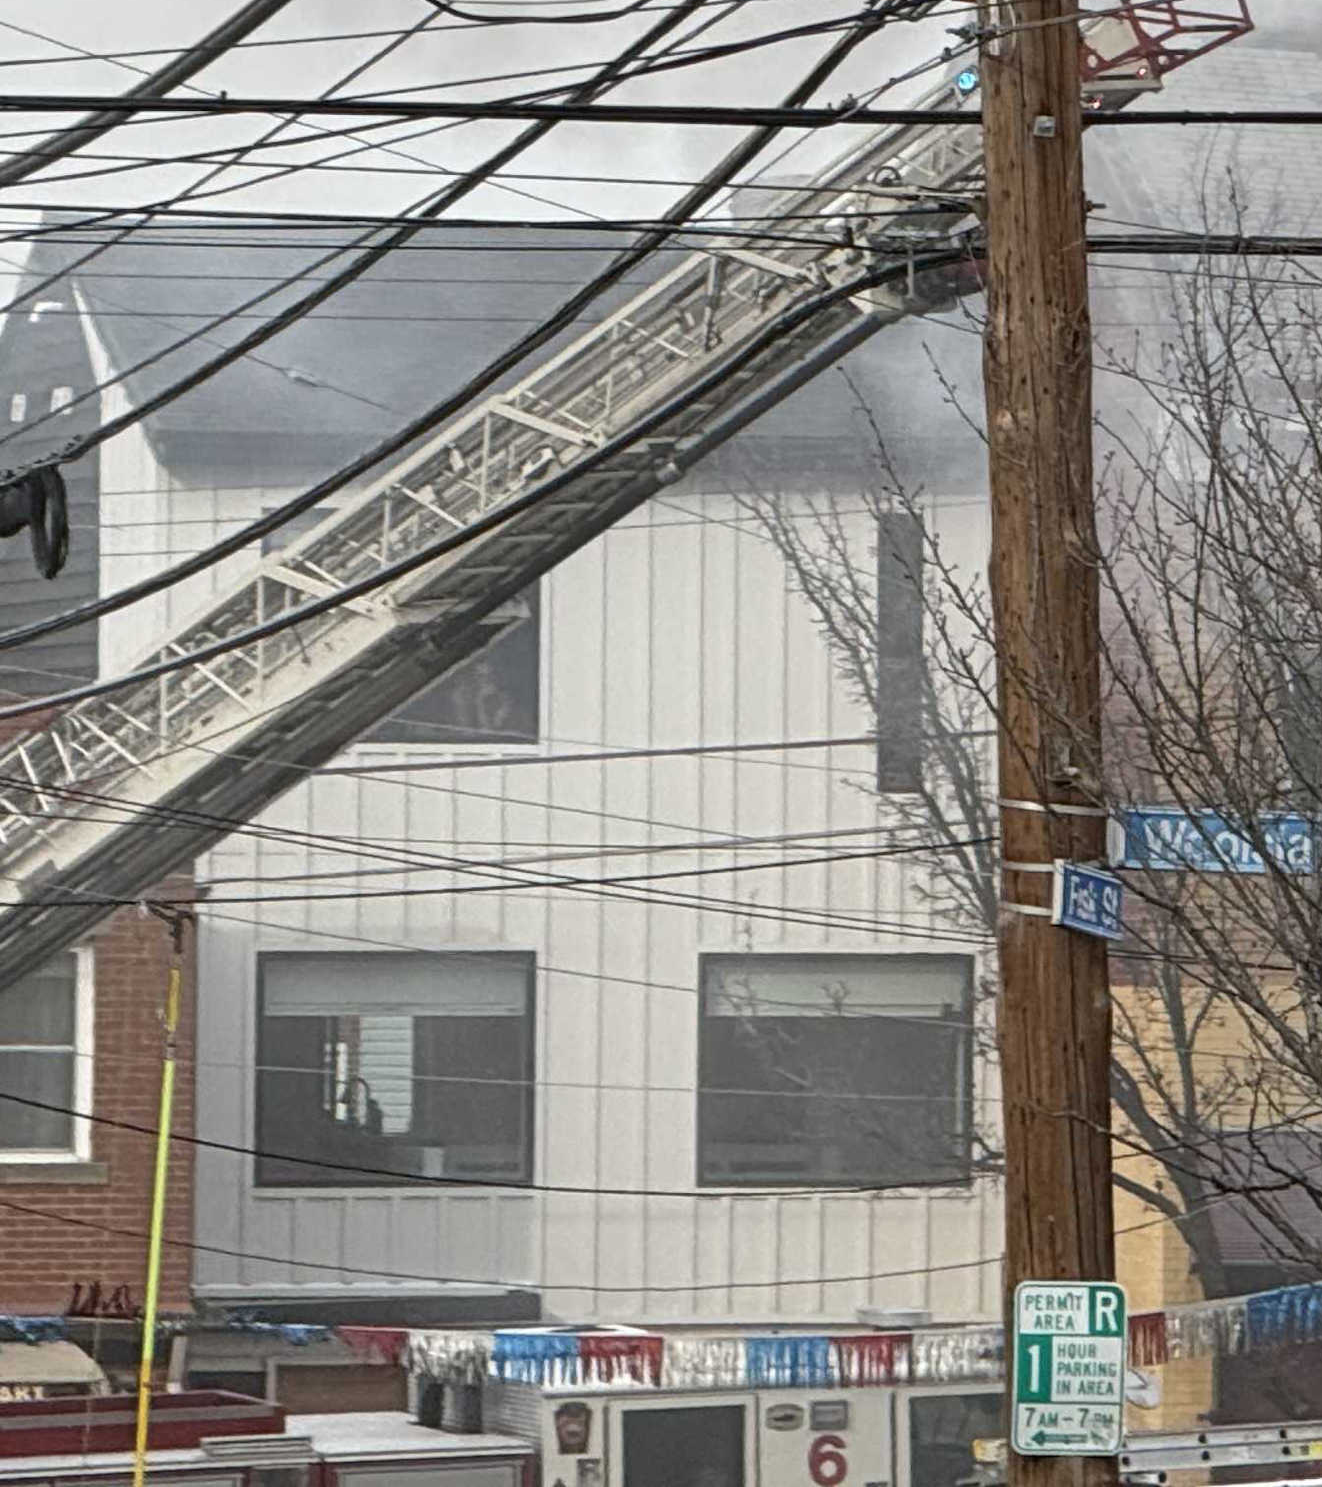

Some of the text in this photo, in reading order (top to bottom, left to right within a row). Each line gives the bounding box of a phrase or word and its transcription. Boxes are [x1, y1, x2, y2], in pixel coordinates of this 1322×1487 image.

[1024, 1290, 1119, 1332] PERMIT R
[1034, 1314, 1076, 1331] AREA
[1057, 1343, 1097, 1359] HOUR
[1027, 1344, 1041, 1394] 1
[1057, 1363, 1118, 1379] PARKING
[1056, 1381, 1115, 1396] IN AREA
[808, 1434, 848, 1487] 6
